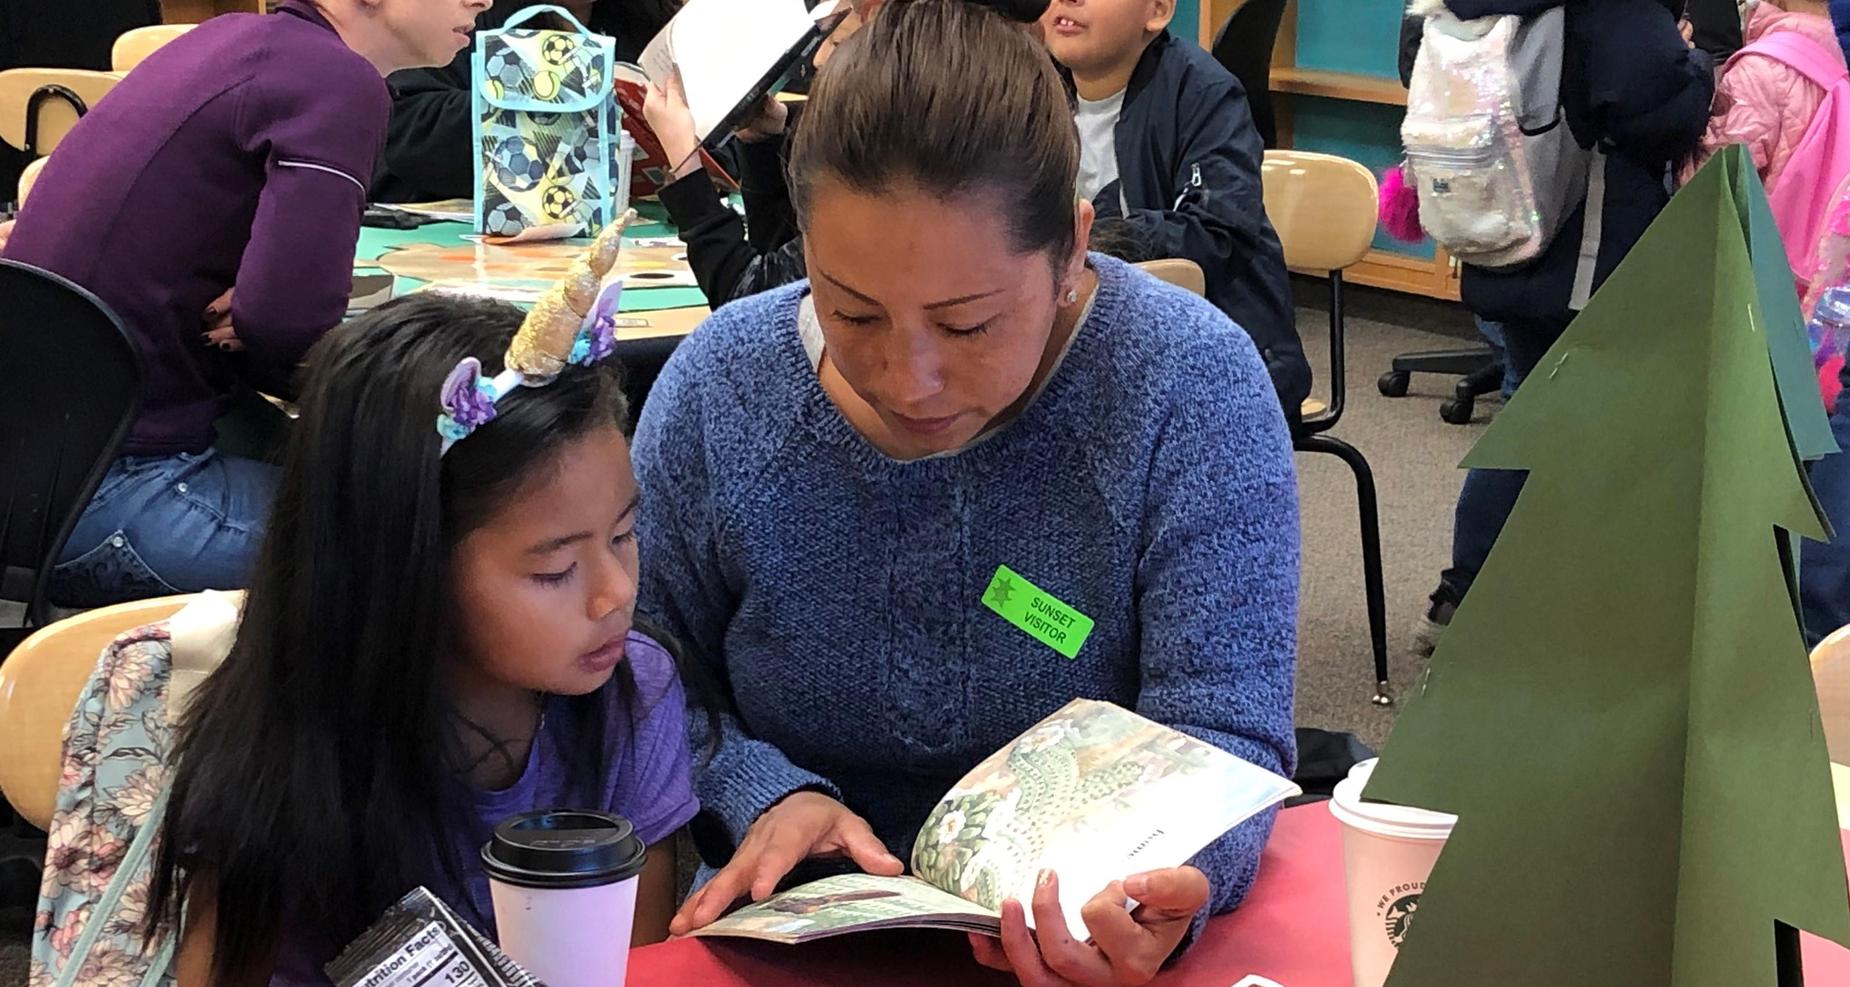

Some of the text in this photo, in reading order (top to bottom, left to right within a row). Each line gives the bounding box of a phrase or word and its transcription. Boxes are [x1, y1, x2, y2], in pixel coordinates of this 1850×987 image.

[1024, 611, 1067, 645] VISITOR
[1030, 596, 1077, 629] SUNSET
[1377, 894, 1389, 909] WE
[364, 955, 408, 987] trition
[405, 926, 441, 957] Facts
[445, 960, 470, 984] 130
